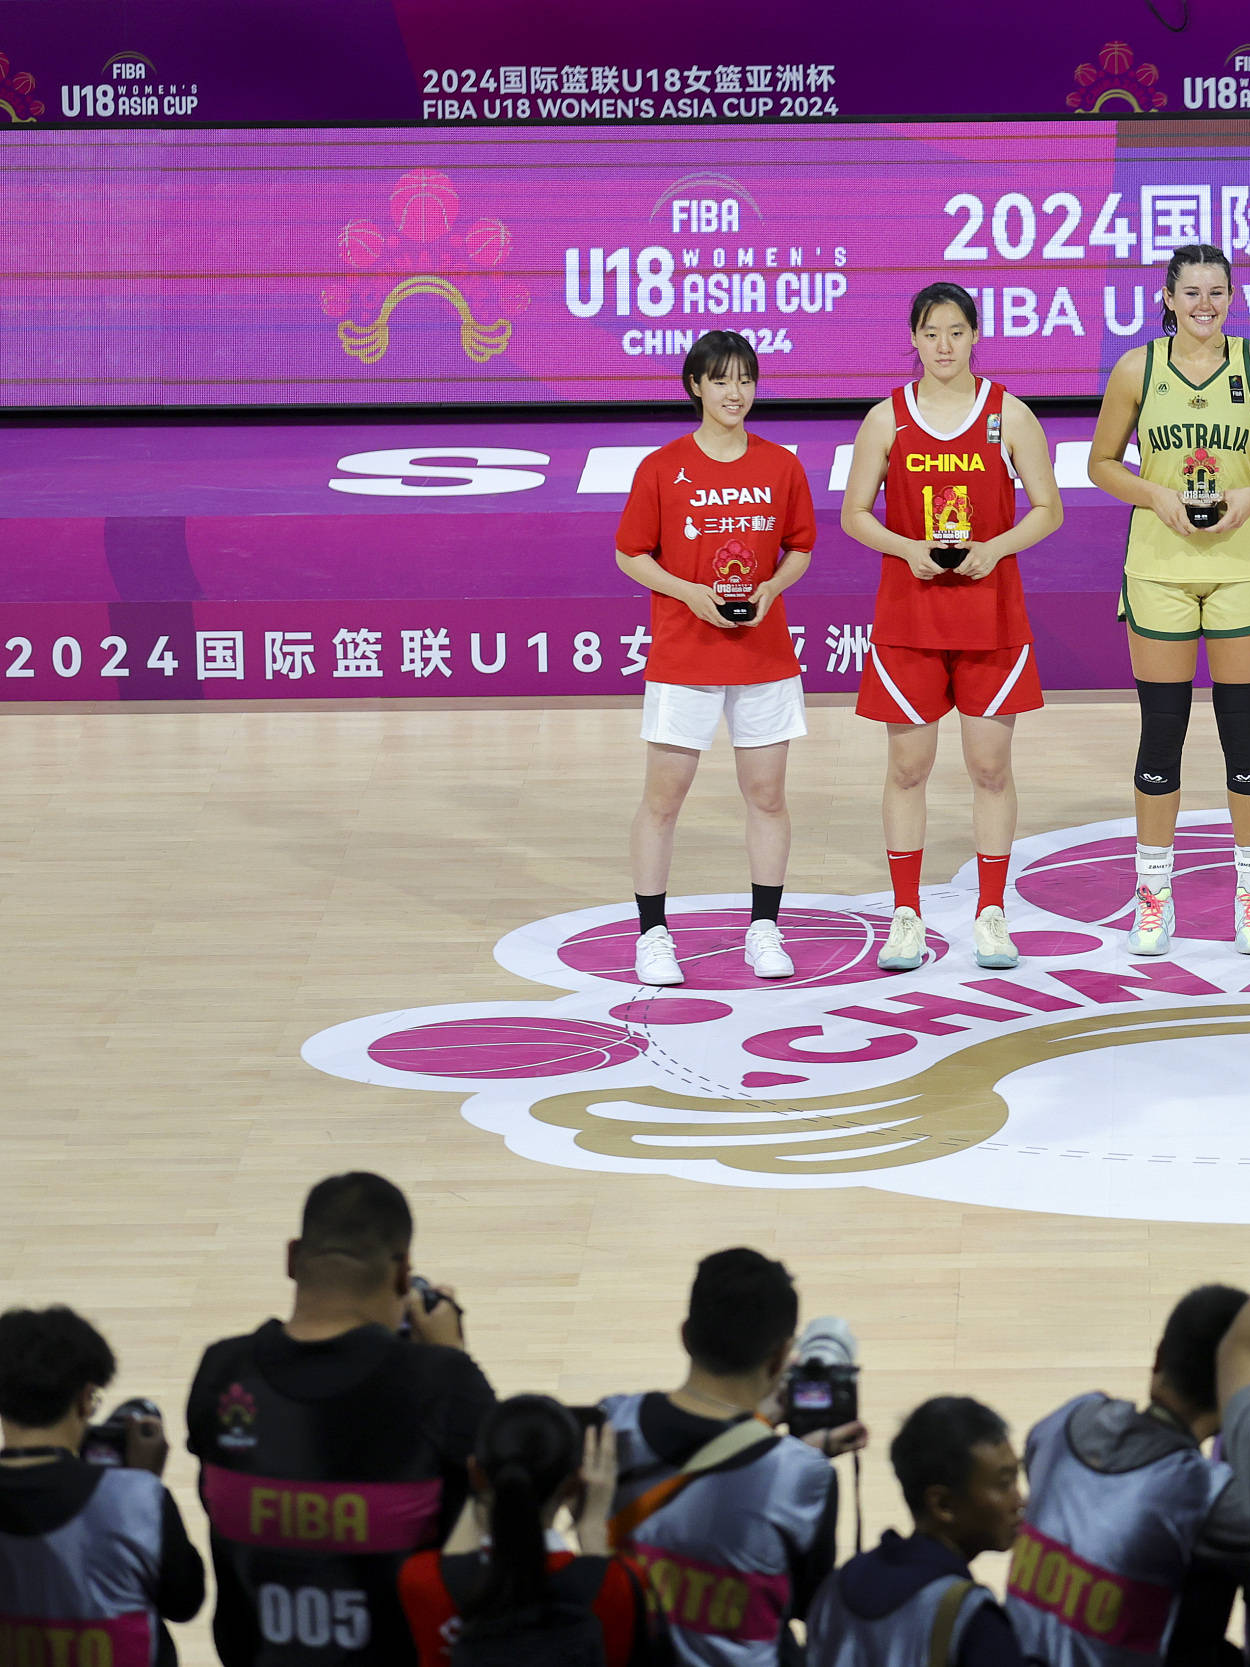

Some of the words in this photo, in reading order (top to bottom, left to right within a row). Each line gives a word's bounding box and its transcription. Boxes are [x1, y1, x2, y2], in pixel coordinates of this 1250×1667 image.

[112, 63, 145, 79] FIBA
[422, 64, 836, 95] 2024国际篮联U18女篮亚洲杯
[61, 84, 115, 117] U18
[118, 84, 198, 95] WOMEN'S
[1184, 77, 1237, 109] U18
[118, 97, 159, 116] ASIA
[163, 96, 198, 115] CUP
[423, 99, 477, 120] FIBA
[484, 98, 531, 120] U18
[537, 97, 655, 119] WOMEN'S
[660, 97, 717, 118] ASIA
[722, 97, 774, 118] CUP
[780, 96, 839, 117] 2024
[672, 199, 740, 233] FIBA
[682, 247, 848, 268] WOMEN'S
[565, 246, 676, 317] U18
[683, 273, 766, 314] ASIA
[776, 272, 848, 313] CUP
[1148, 424, 1249, 454] AUSTRALIA
[906, 453, 986, 472] CHINA
[690, 487, 771, 507] JAPAN
[703, 515, 776, 534] 三井不動産
[250, 1487, 369, 1543] FIBA
[260, 1584, 371, 1649] 005
